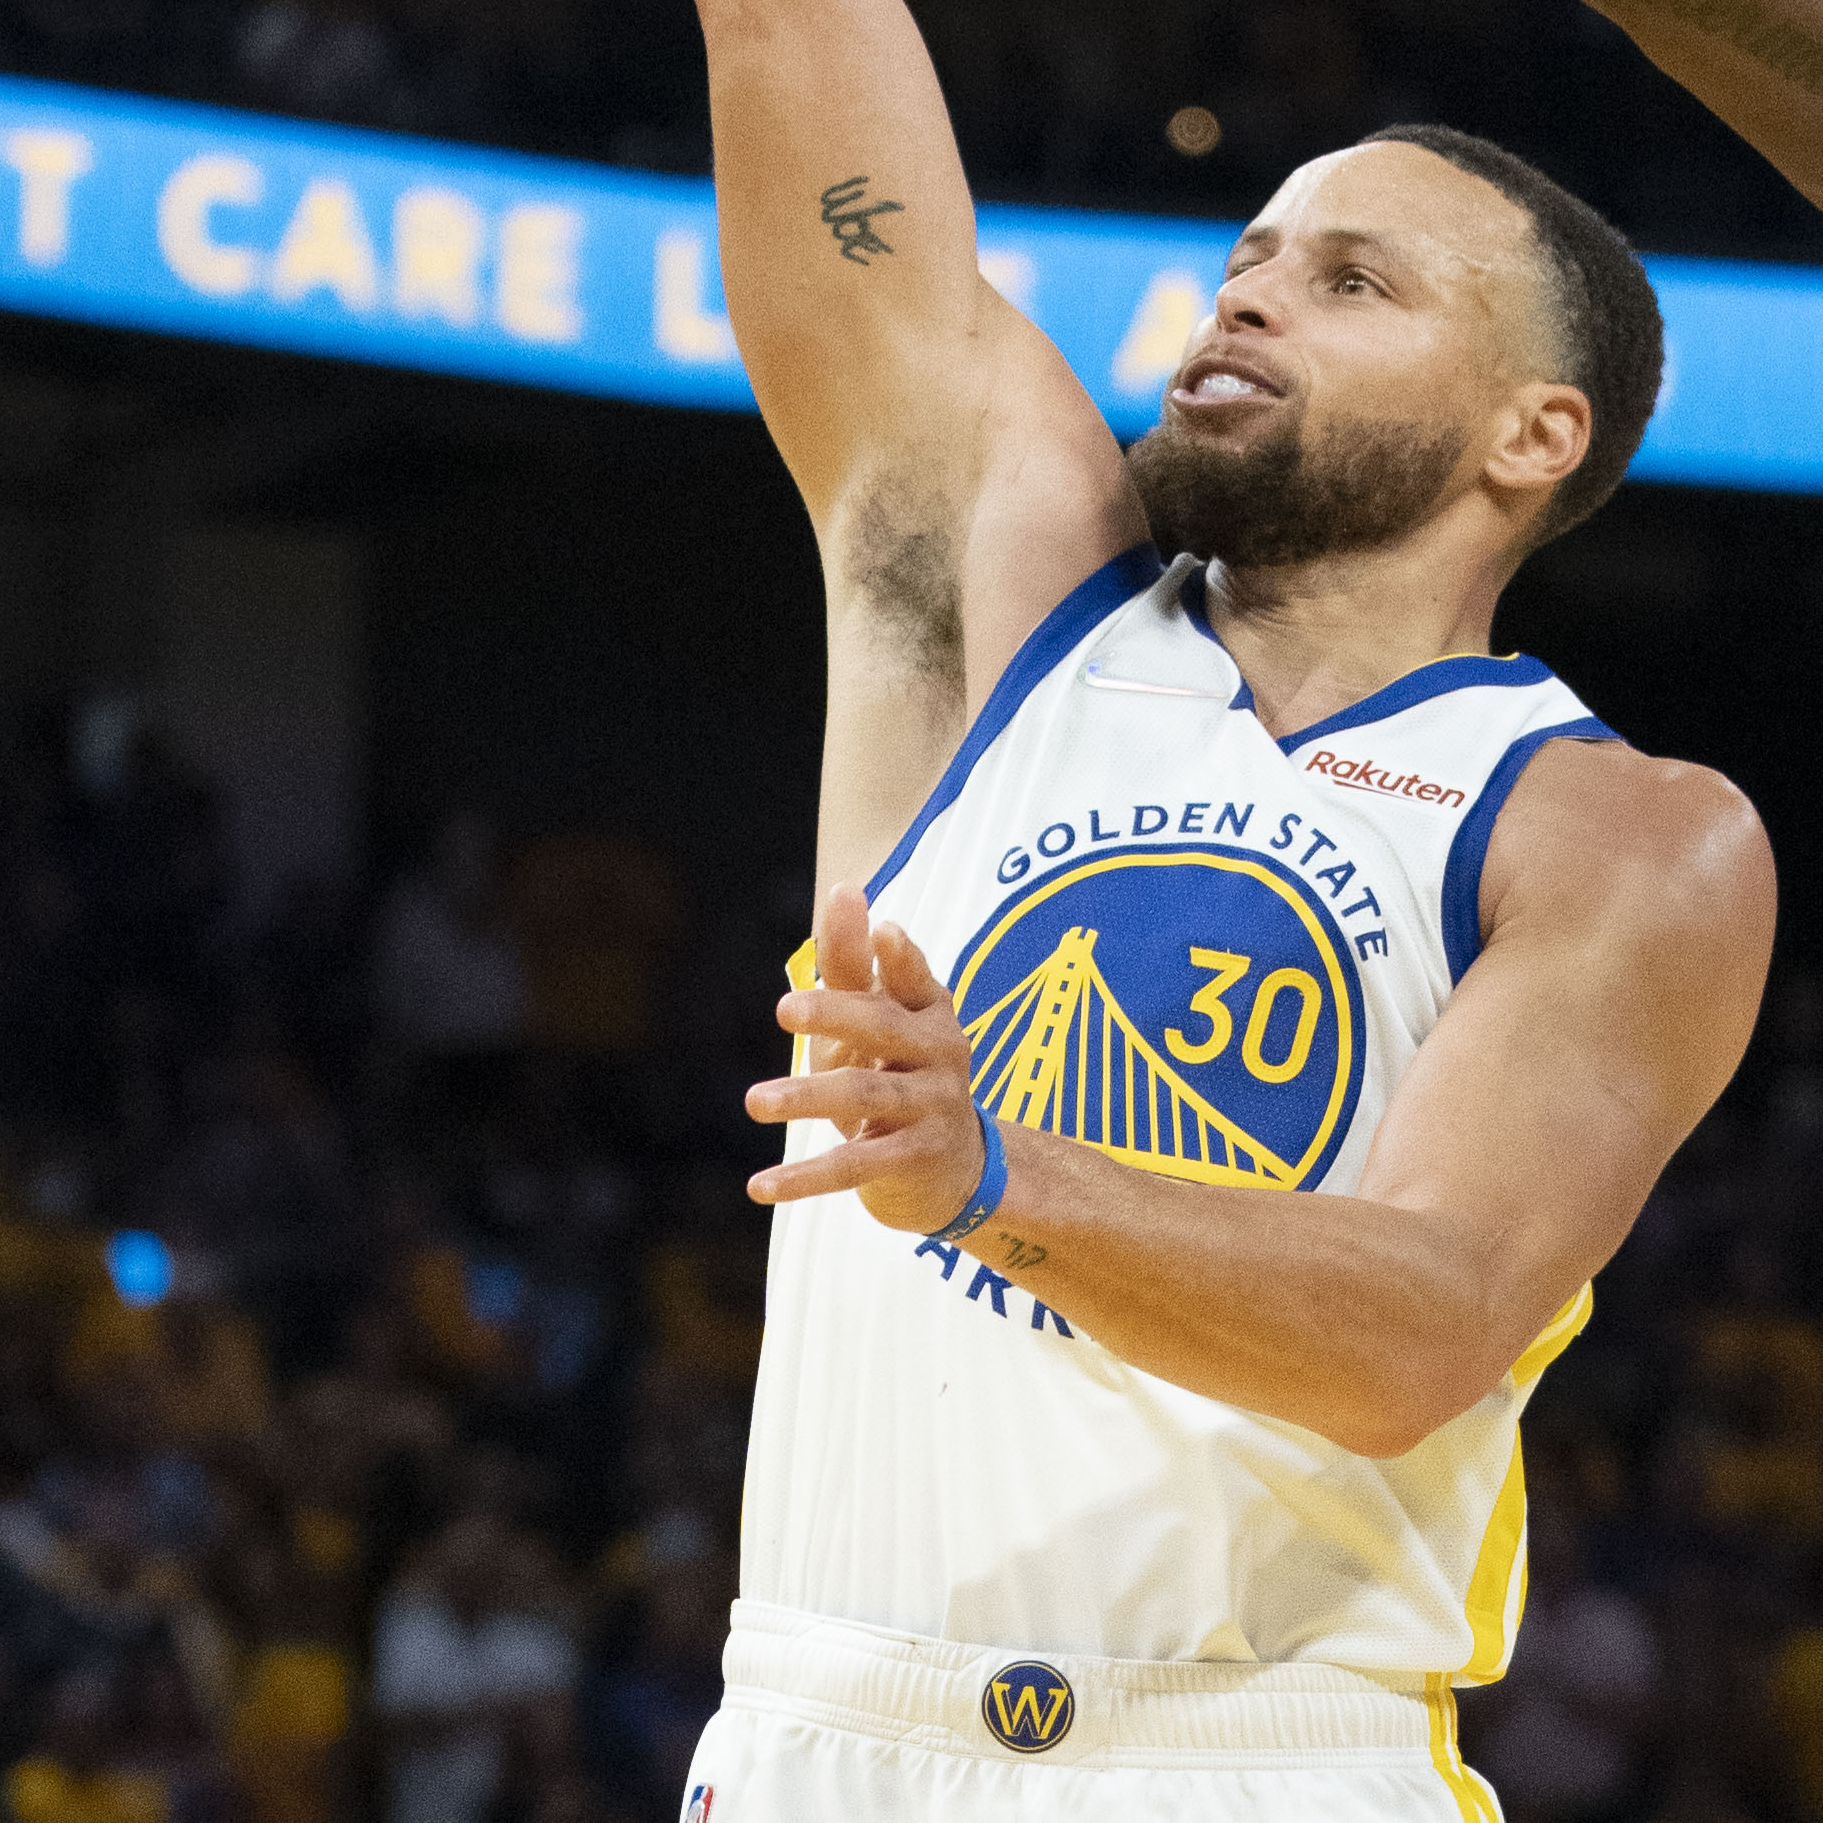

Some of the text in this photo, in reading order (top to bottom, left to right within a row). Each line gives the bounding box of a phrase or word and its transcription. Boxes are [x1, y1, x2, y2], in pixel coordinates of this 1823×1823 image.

[156, 151, 586, 342] CARE
[1304, 749, 1466, 810] Rakuten
[997, 801, 1392, 963] GOLDEN STATE
[1165, 946, 1323, 1085] 30
[990, 1682, 1069, 1740] W
